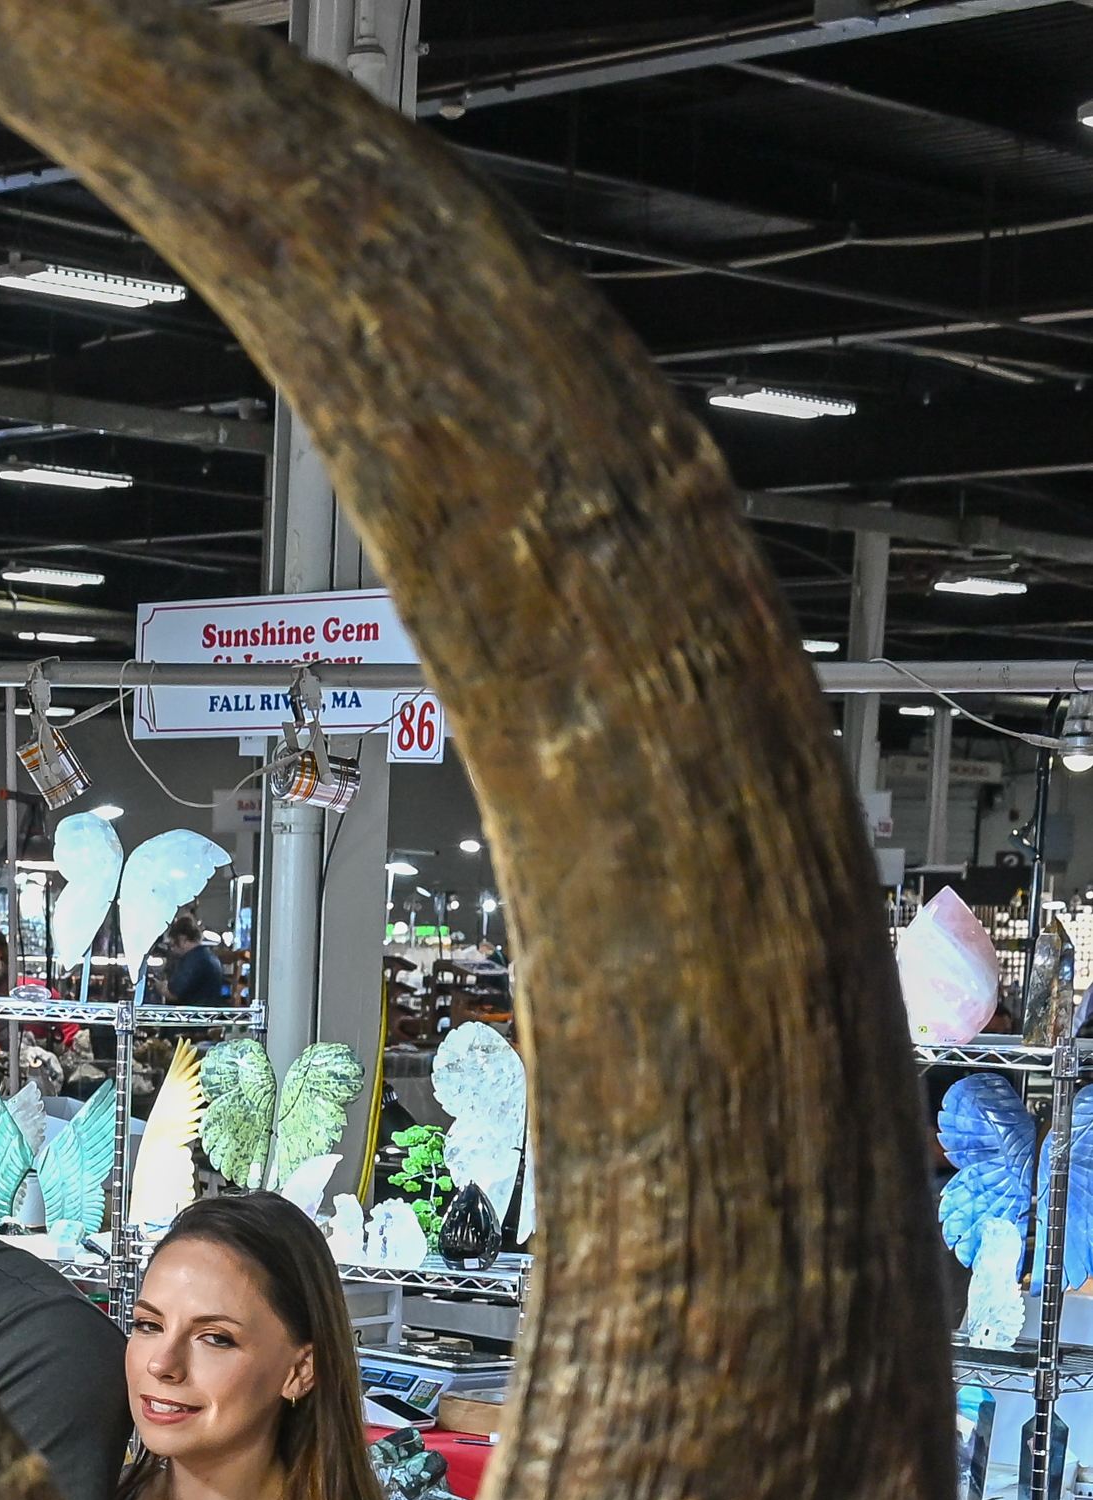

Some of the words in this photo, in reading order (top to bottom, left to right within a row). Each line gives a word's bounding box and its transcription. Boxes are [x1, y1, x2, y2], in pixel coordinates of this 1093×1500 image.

[202, 620, 315, 648] Sunshine
[323, 617, 379, 643] Gem
[209, 694, 255, 712] FALL
[332, 691, 362, 708] MA
[397, 700, 435, 751] 86
